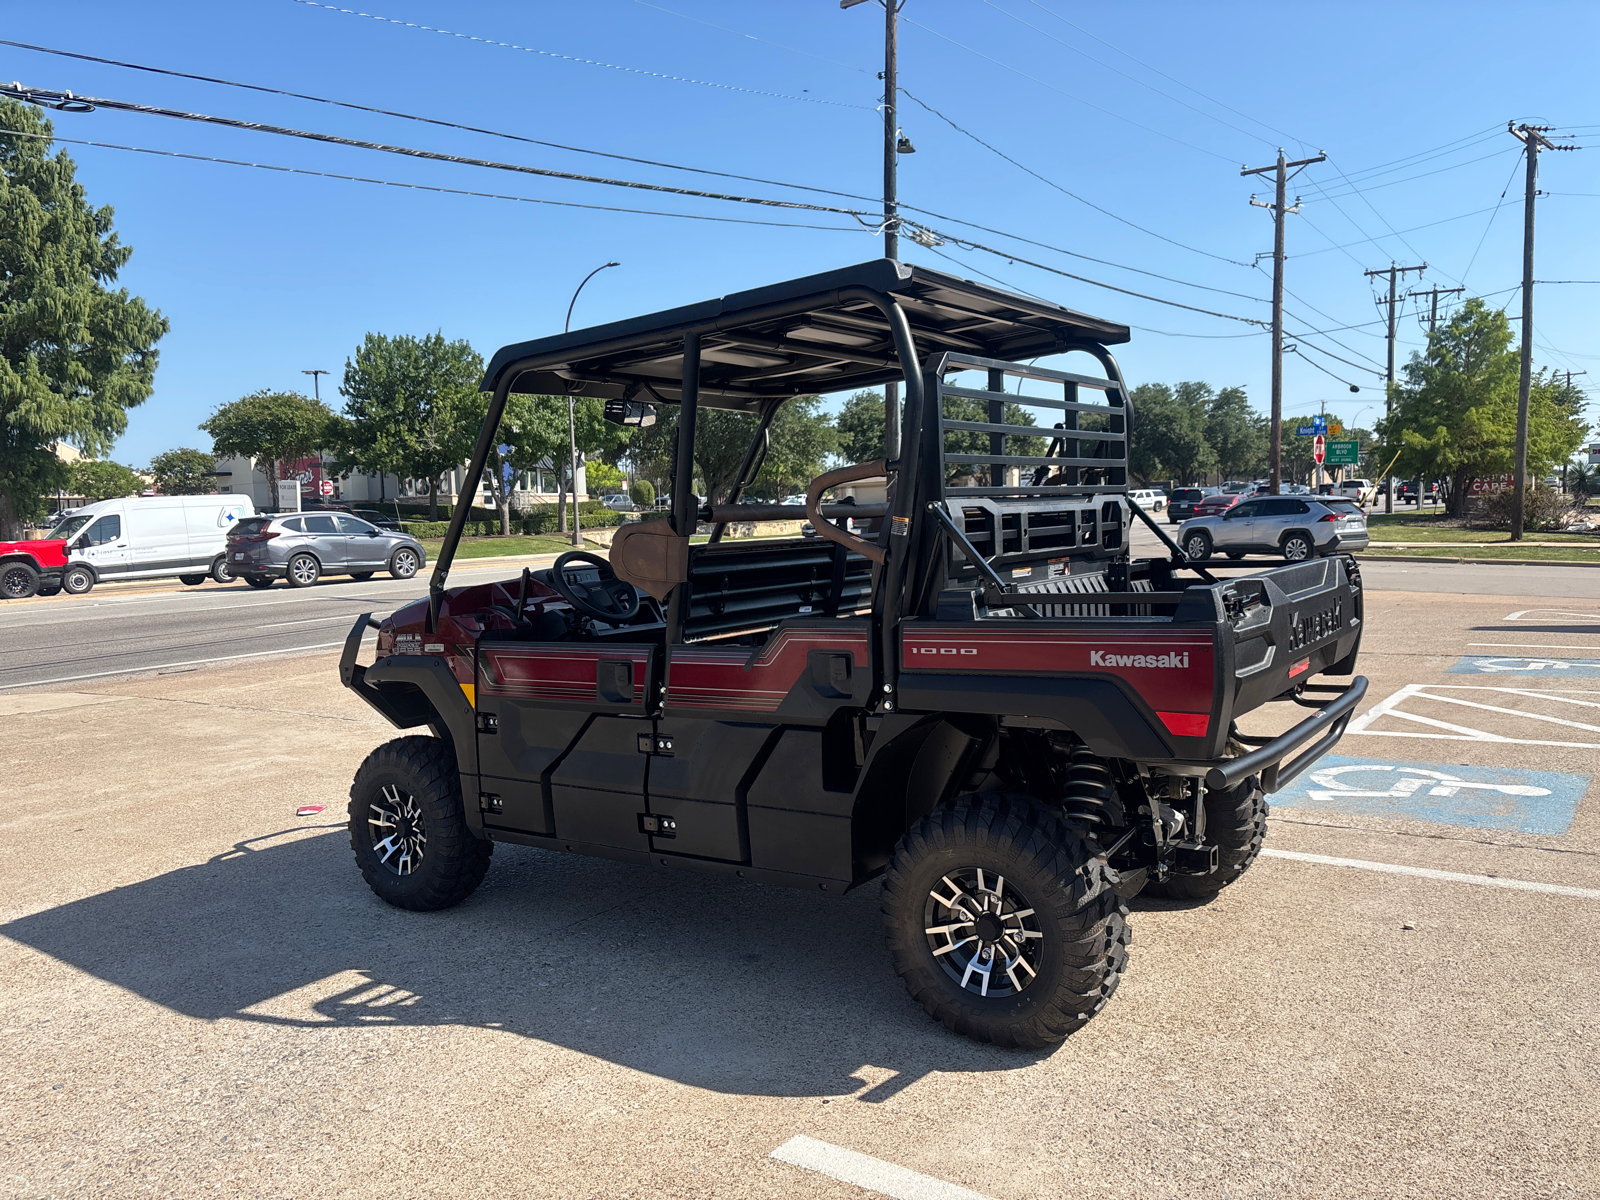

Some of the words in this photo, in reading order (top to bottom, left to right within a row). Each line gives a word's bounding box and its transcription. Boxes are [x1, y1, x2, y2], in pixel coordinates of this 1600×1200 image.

[1300, 427, 1315, 435] Knight
[1472, 481, 1508, 491] CARE
[1288, 595, 1343, 653] Kawasaki
[911, 647, 978, 655] 1000
[1090, 650, 1189, 669] Kawasaki
